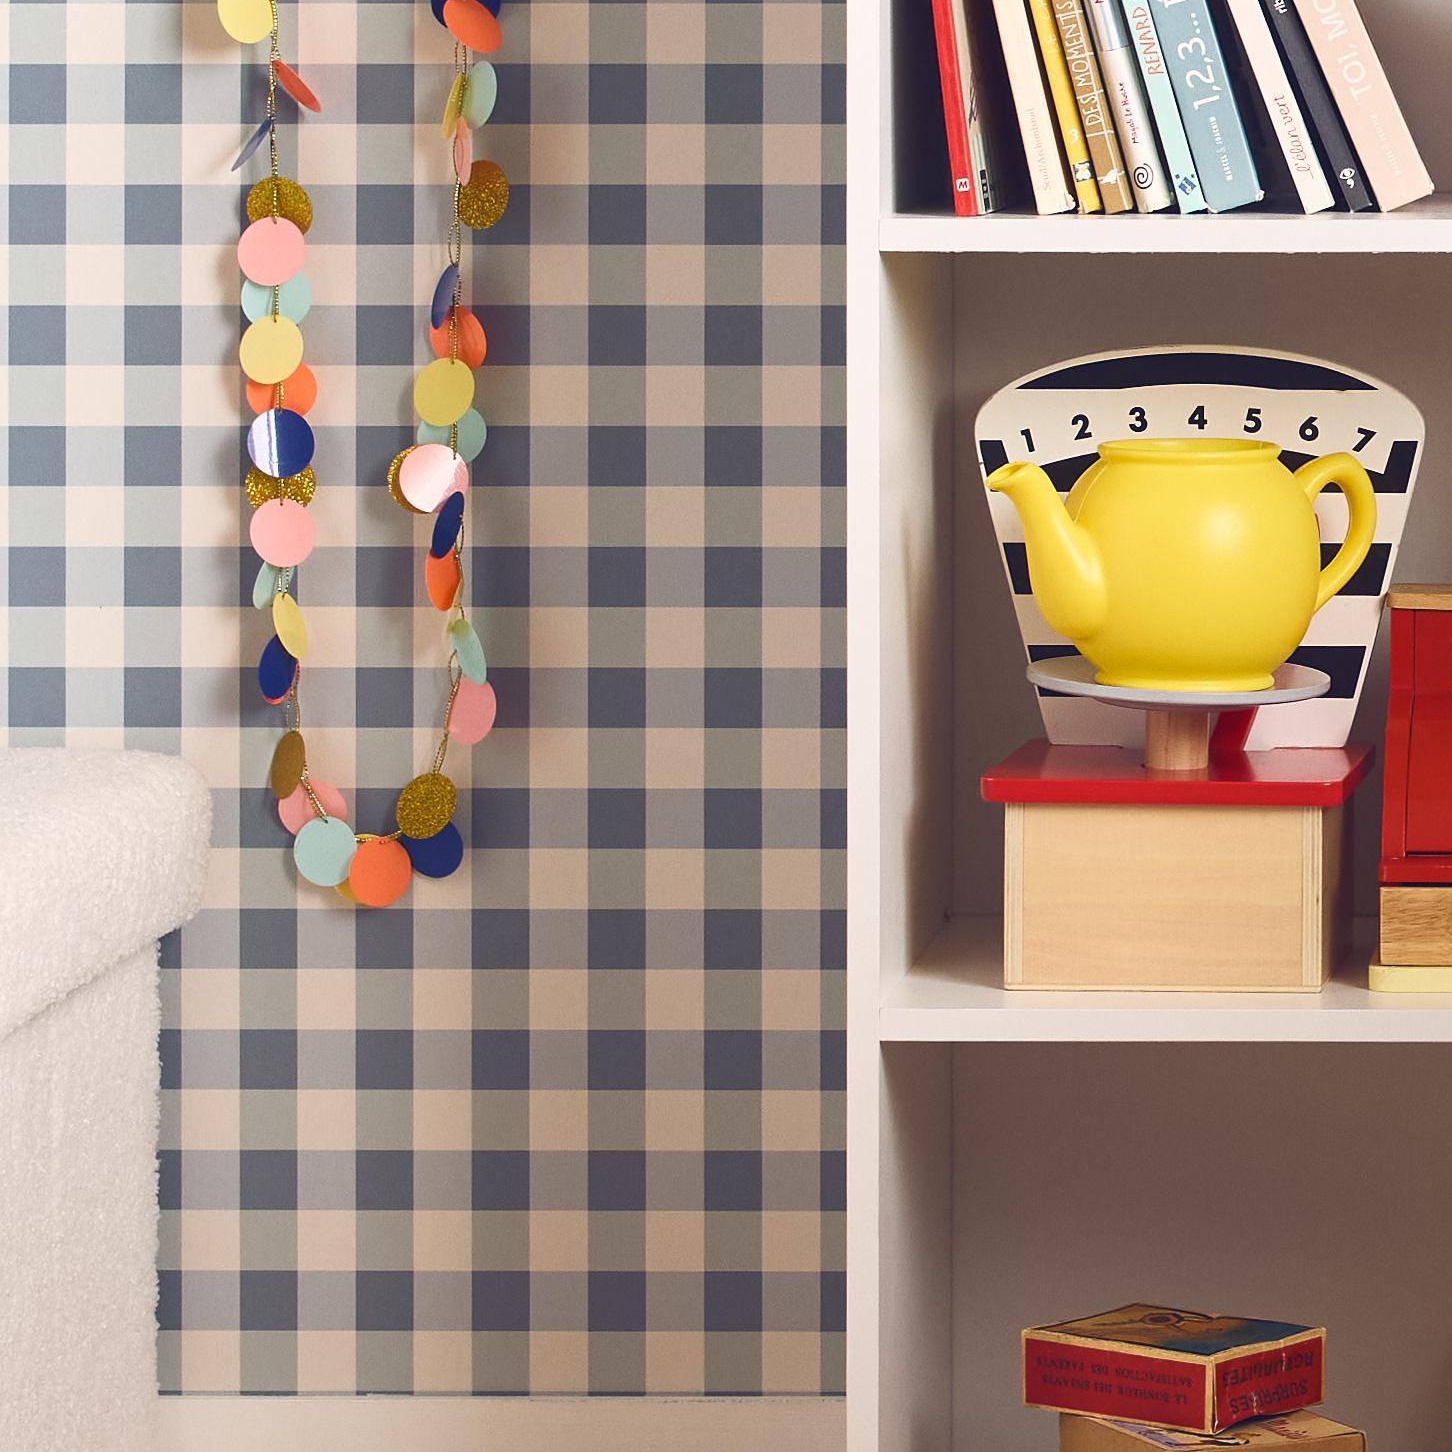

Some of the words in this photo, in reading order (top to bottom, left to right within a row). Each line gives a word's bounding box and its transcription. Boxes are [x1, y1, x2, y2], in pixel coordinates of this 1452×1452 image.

[1055, 0, 1093, 87] MOMENTS
[1129, 4, 1164, 77] RENARD
[1332, 41, 1375, 101] TOI,
[1079, 94, 1102, 126] DES
[1271, 93, 1293, 125] vert
[1020, 428, 1035, 453] 1
[1071, 414, 1091, 440] 2
[1128, 407, 1148, 432] 3
[1188, 405, 1208, 430] 4
[1243, 408, 1262, 433] 5
[1298, 417, 1319, 441] 6
[1352, 427, 1377, 453] 7
